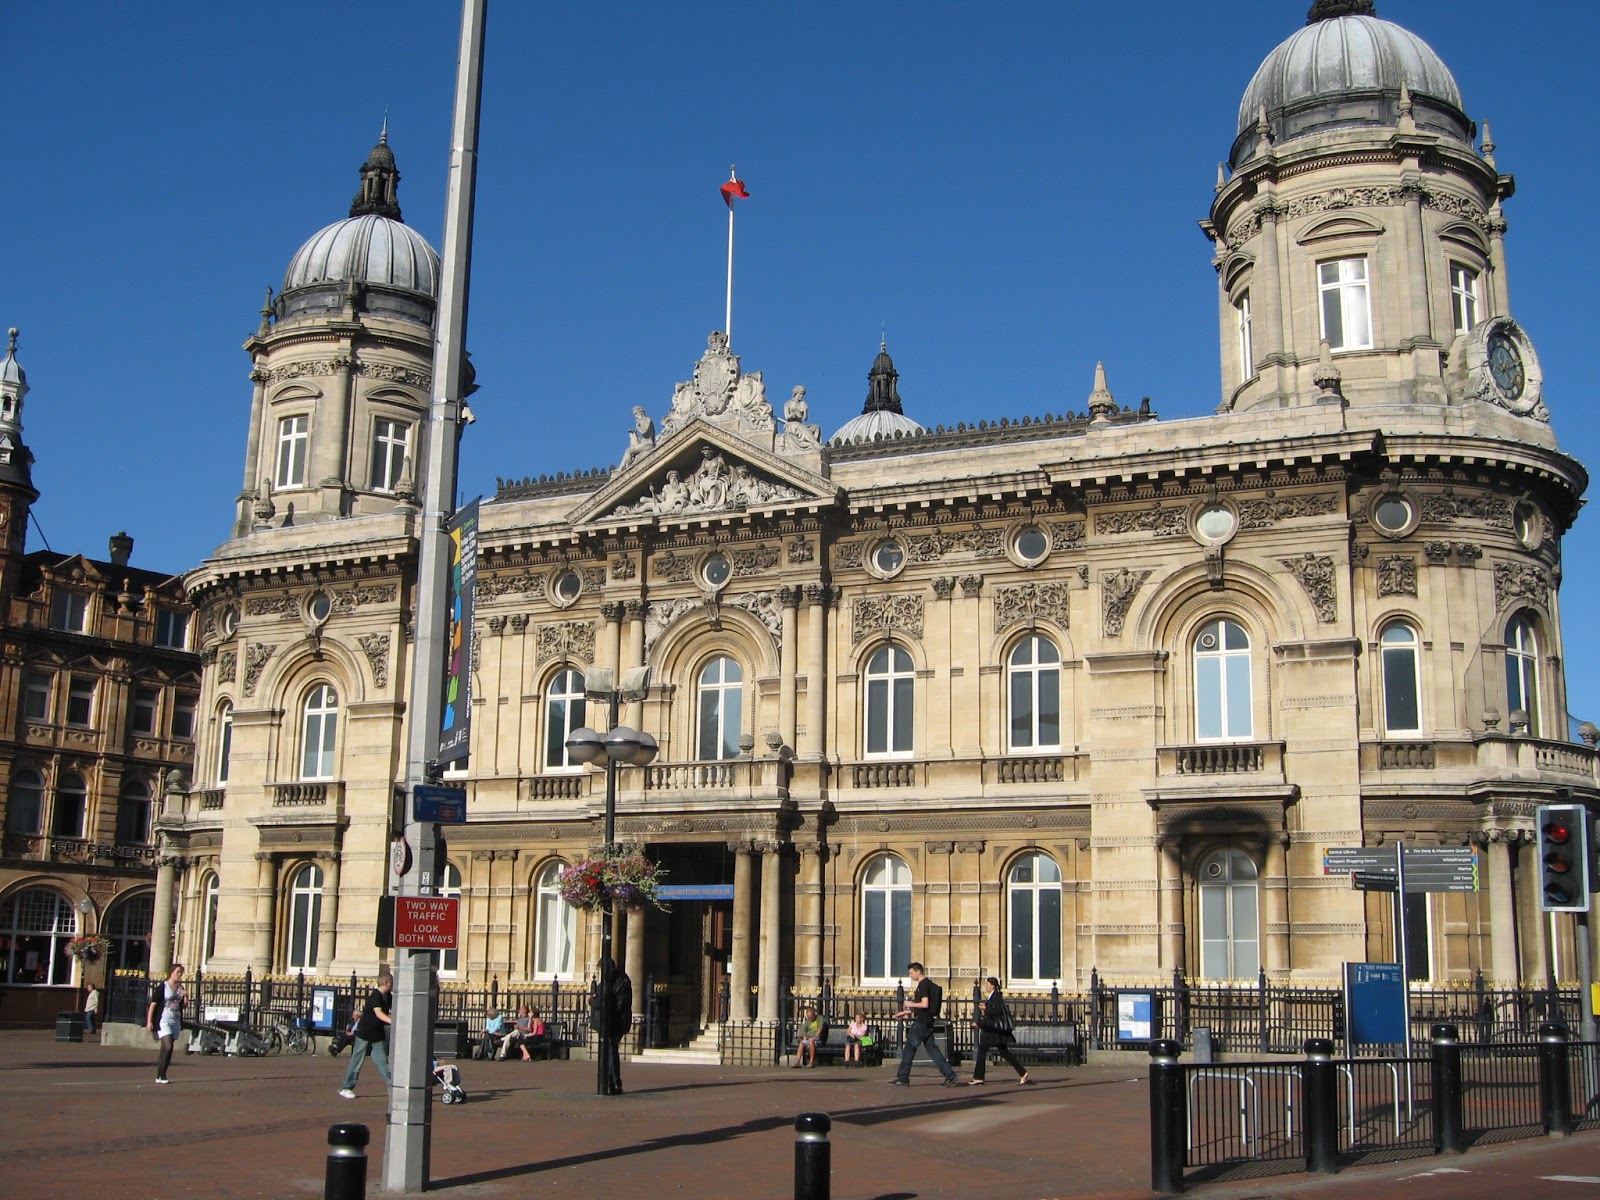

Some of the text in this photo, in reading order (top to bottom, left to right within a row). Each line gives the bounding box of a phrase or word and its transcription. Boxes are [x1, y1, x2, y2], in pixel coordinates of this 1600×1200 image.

[109, 845, 155, 859] NERO
[405, 901, 449, 911] TWO WAY
[408, 911, 446, 921] TRAFFIC
[413, 924, 439, 933] LOOK
[398, 933, 453, 944] BOTH WAYS
